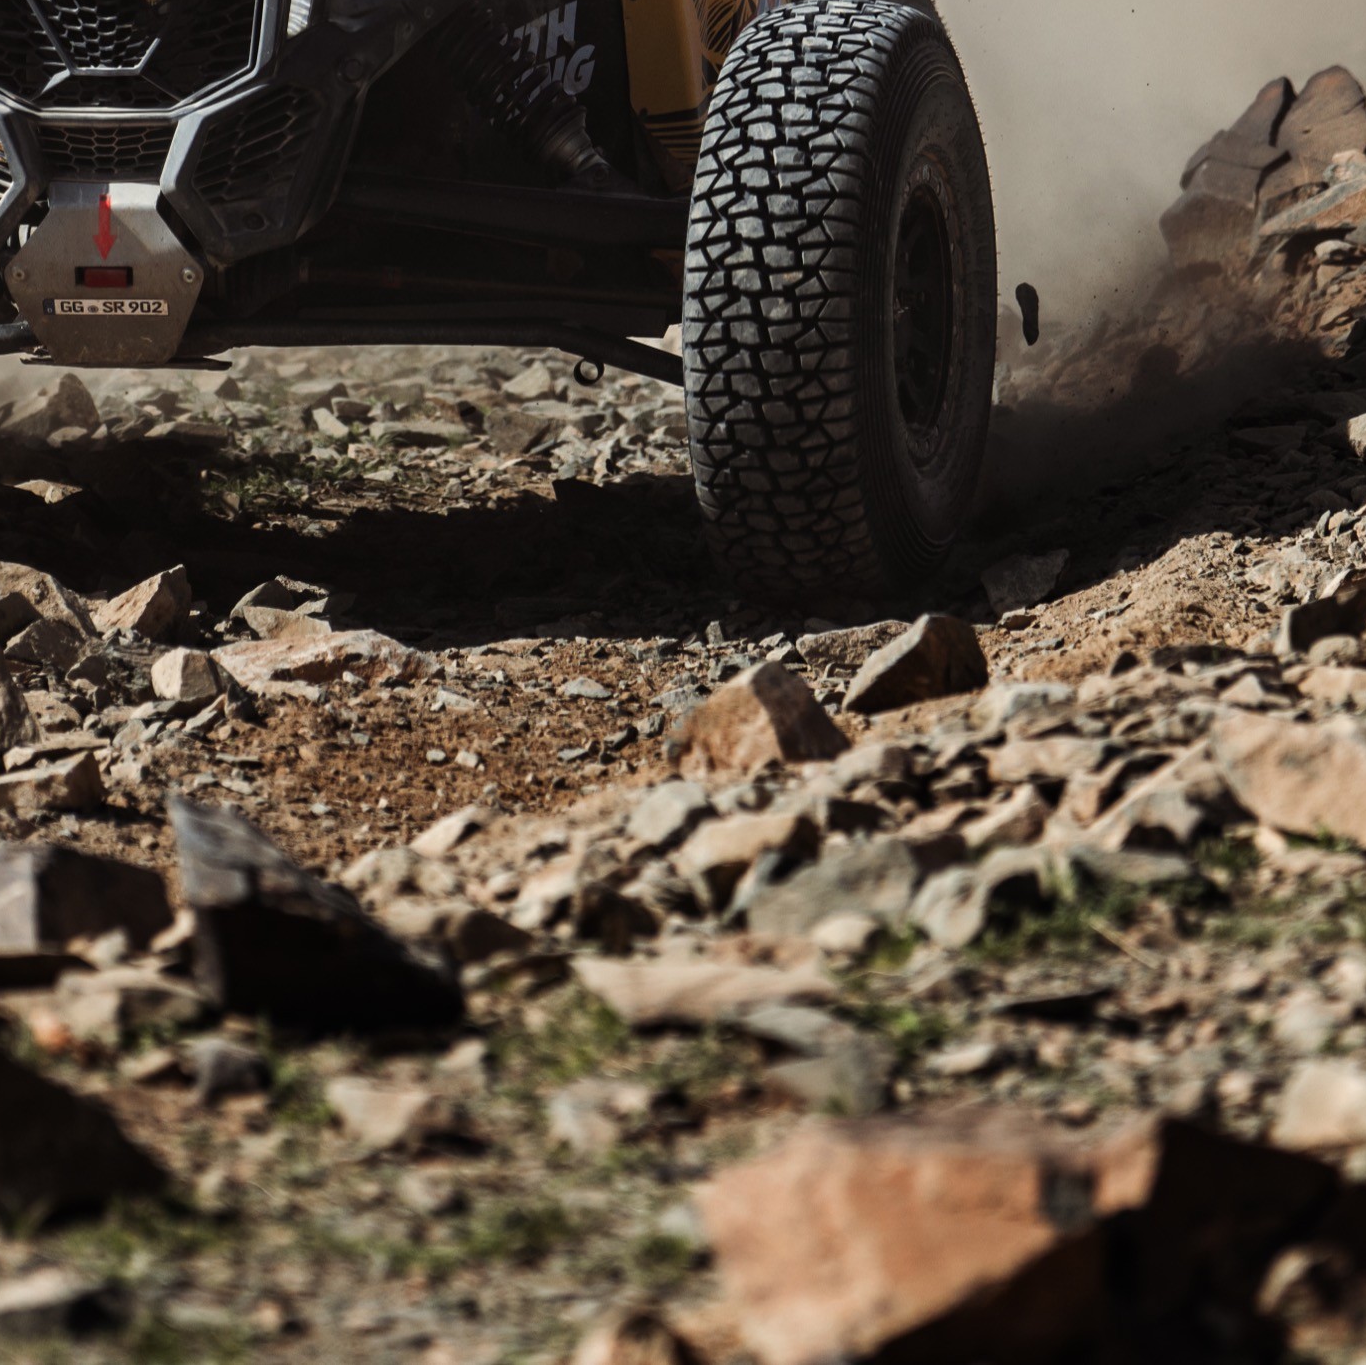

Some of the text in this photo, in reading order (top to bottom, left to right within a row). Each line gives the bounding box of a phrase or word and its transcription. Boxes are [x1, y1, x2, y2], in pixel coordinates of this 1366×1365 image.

[60, 301, 84, 313] GG
[102, 301, 126, 313] SR
[129, 301, 162, 313] 902
